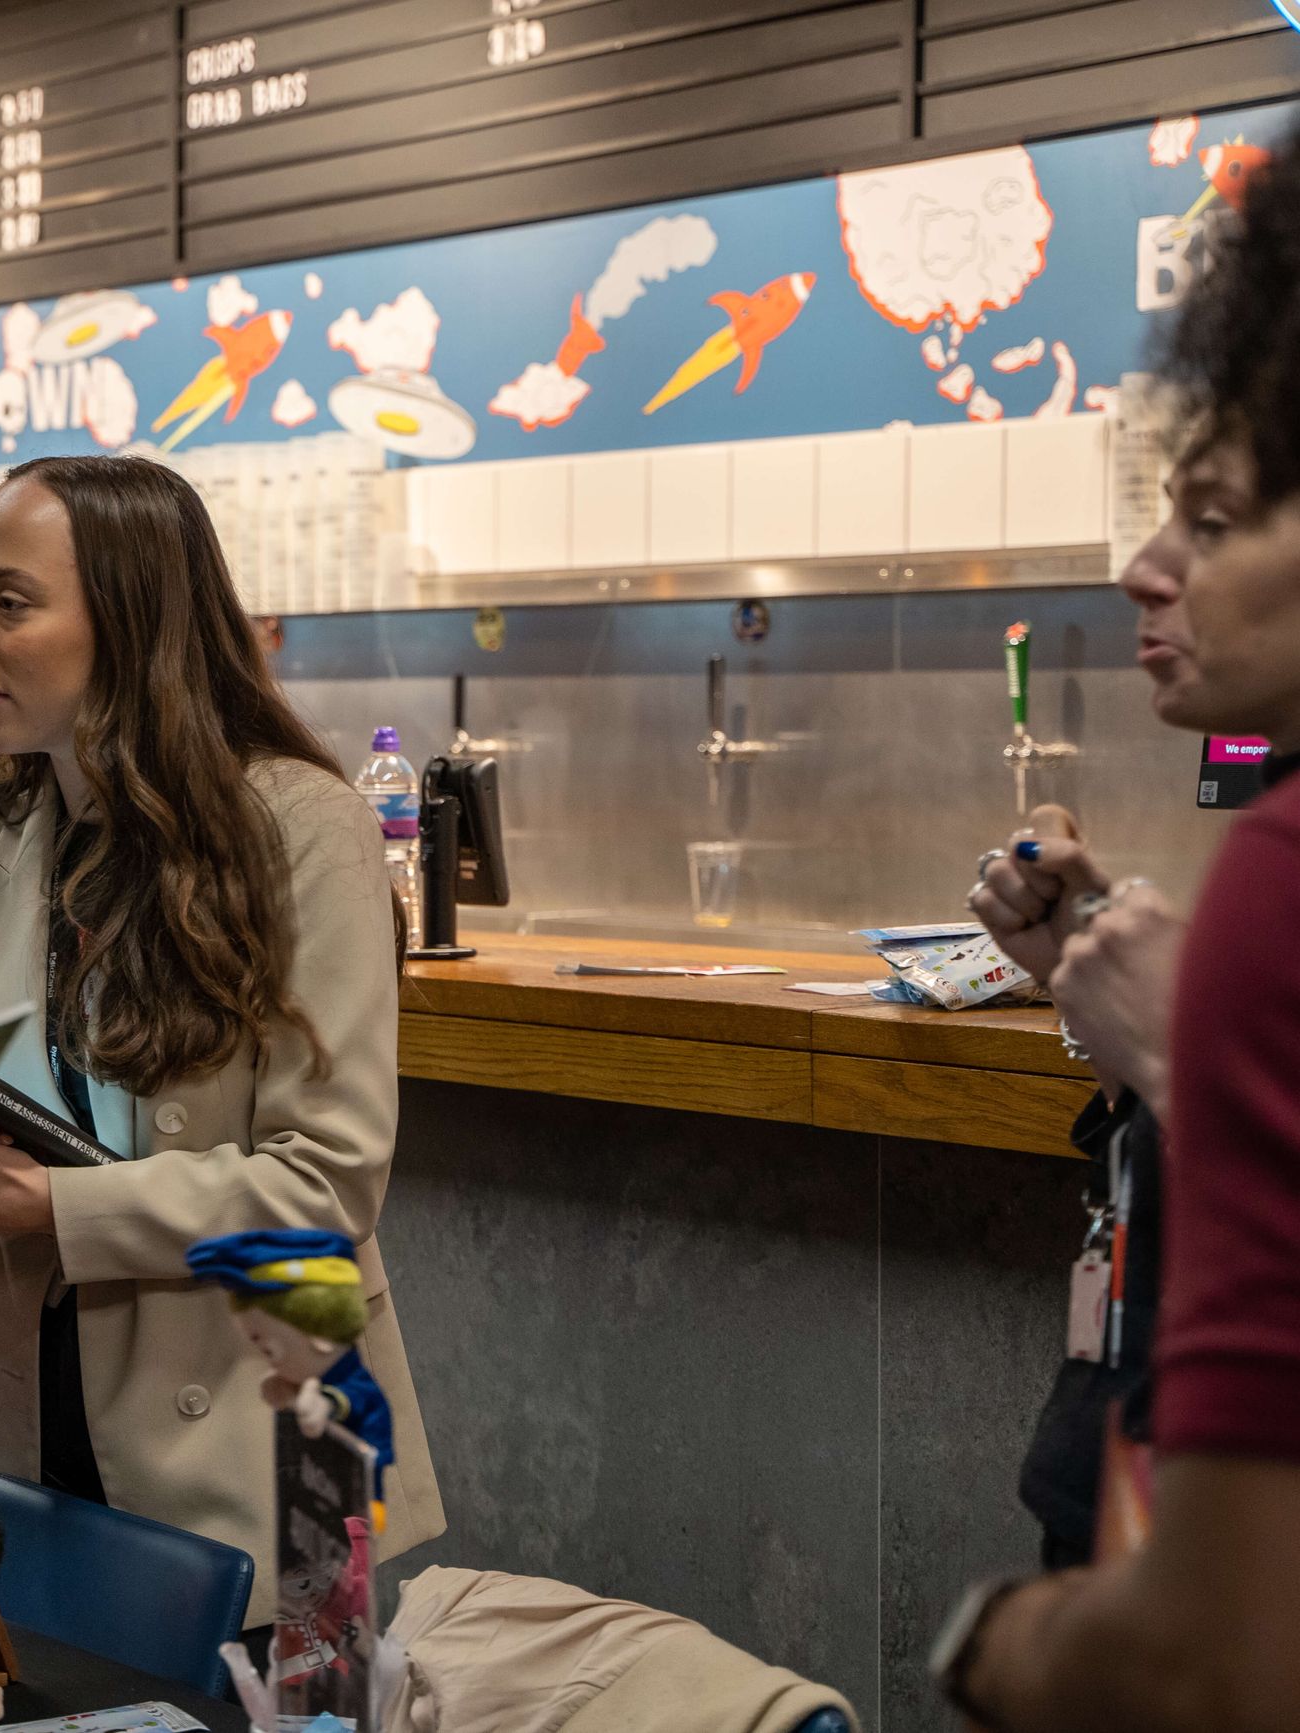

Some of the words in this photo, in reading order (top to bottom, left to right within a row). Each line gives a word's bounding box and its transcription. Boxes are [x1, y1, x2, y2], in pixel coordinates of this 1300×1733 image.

[187, 37, 255, 85] CRISPS
[187, 88, 241, 129] GRAB
[252, 71, 308, 116] BAGS
[1225, 744, 1240, 754] We
[19, 1106, 73, 1143] ASSESSMENT
[76, 1138, 107, 1164] TABLET
